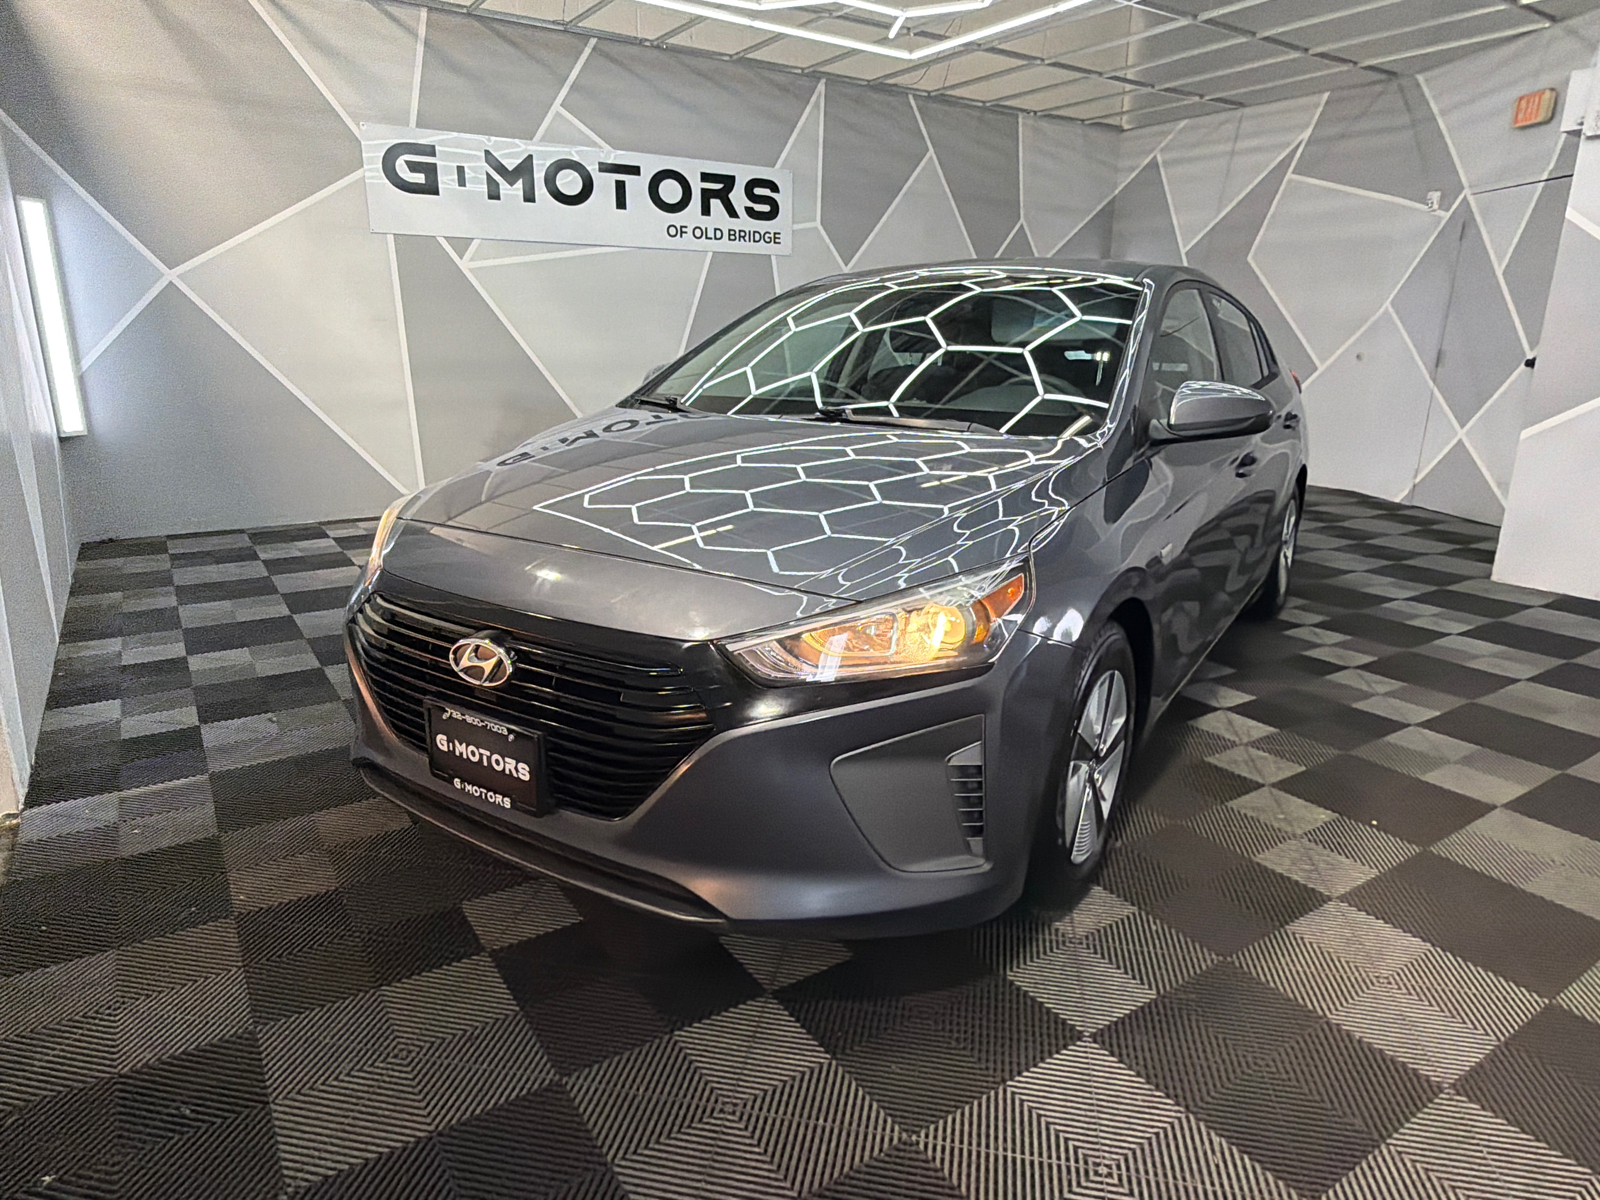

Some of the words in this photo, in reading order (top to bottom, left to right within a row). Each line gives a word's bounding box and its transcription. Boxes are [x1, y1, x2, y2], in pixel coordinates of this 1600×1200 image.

[666, 224, 688, 240] OF
[692, 225, 724, 242] OLD
[728, 227, 782, 245] BRIDGE
